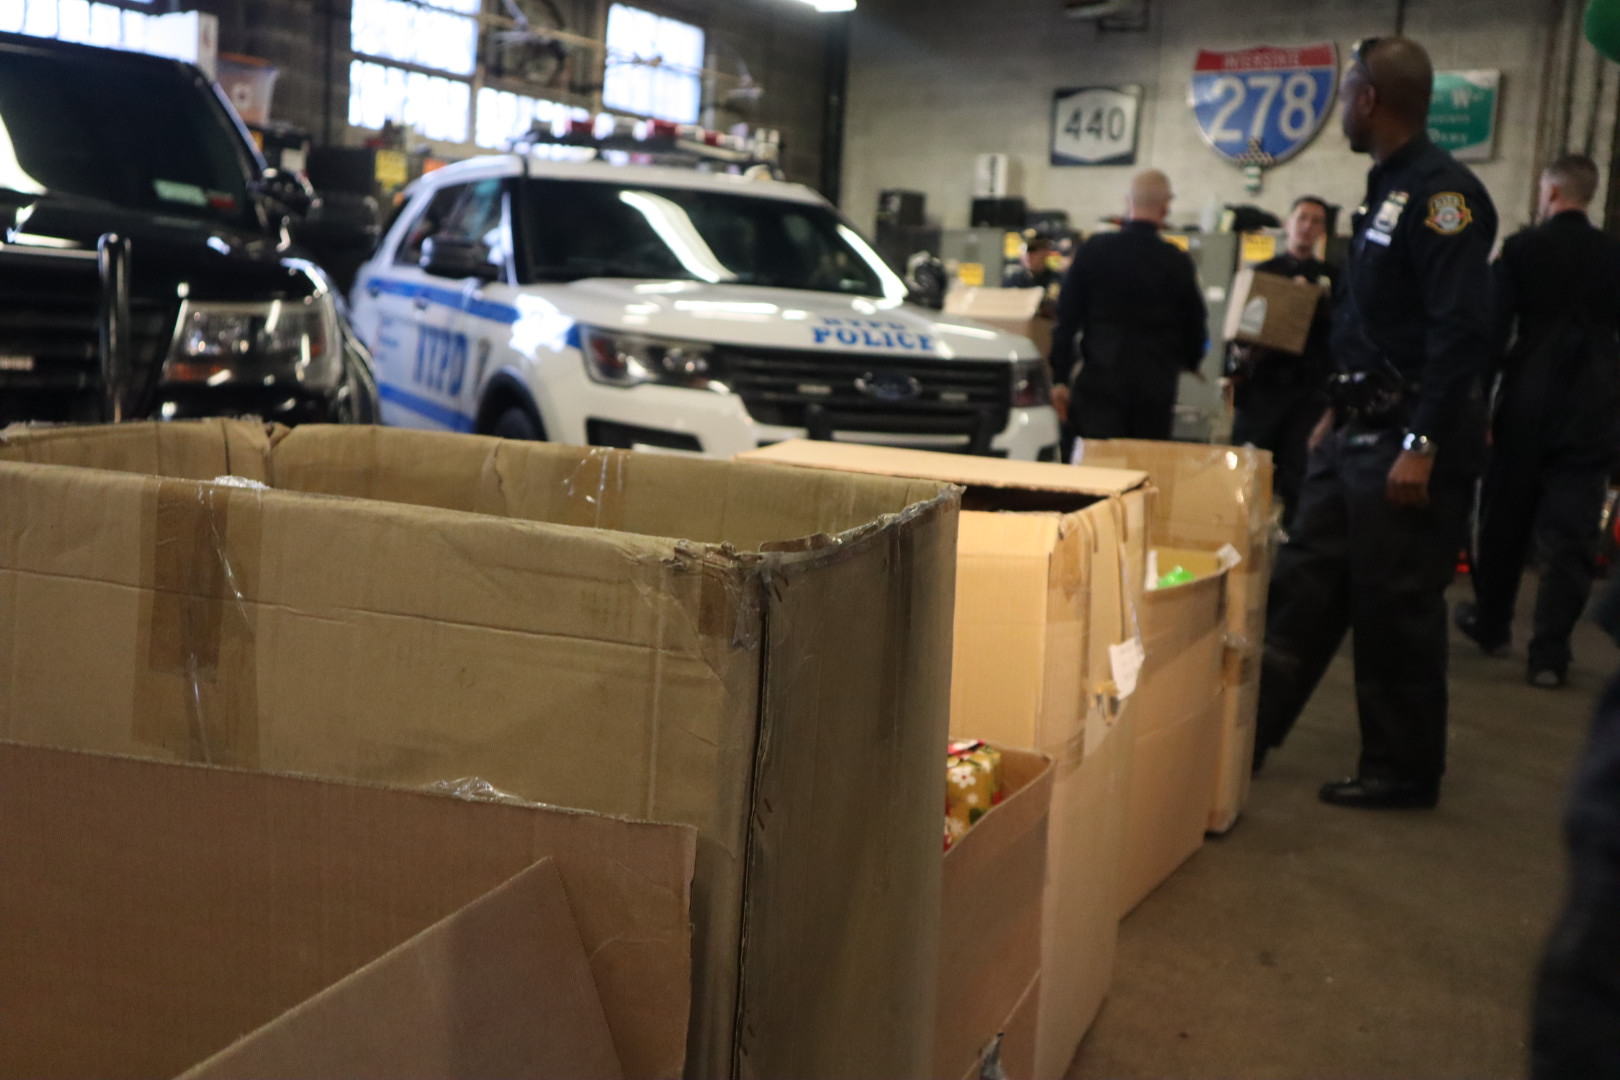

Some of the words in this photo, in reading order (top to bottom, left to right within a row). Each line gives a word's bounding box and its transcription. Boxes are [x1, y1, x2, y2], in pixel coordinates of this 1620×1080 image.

[1064, 106, 1126, 143] 440
[1208, 72, 1318, 142] 278
[811, 326, 936, 351] POLICE
